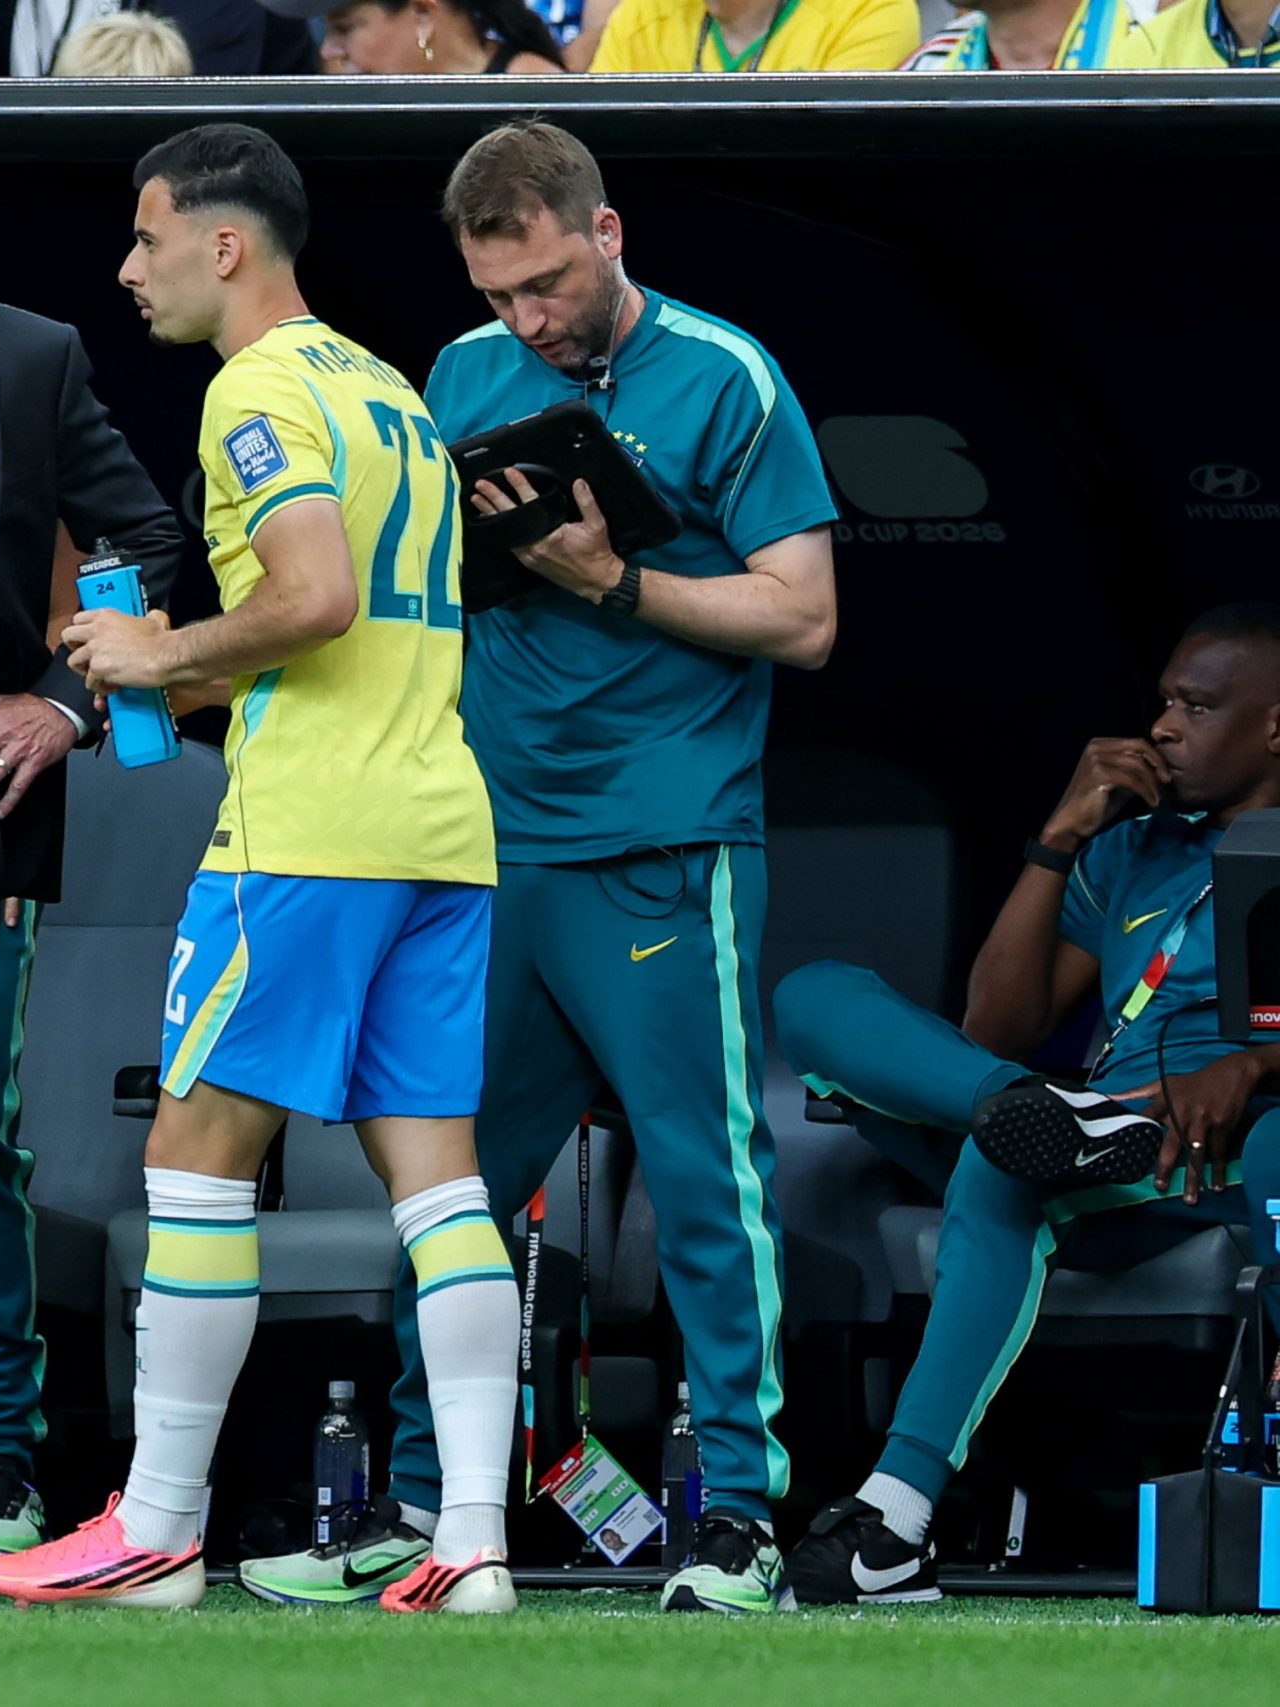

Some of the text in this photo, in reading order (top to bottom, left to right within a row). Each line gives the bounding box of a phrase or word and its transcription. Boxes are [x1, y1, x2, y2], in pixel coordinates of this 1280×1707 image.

[235, 436, 269, 464] UNITES
[364, 399, 462, 631] 22
[1183, 503, 1280, 521] HYUNDA
[857, 522, 910, 543] CUP
[913, 520, 1008, 543] 2026
[96, 581, 115, 595] 24
[521, 1231, 540, 1371] FIFA WORLD CUP 2026
